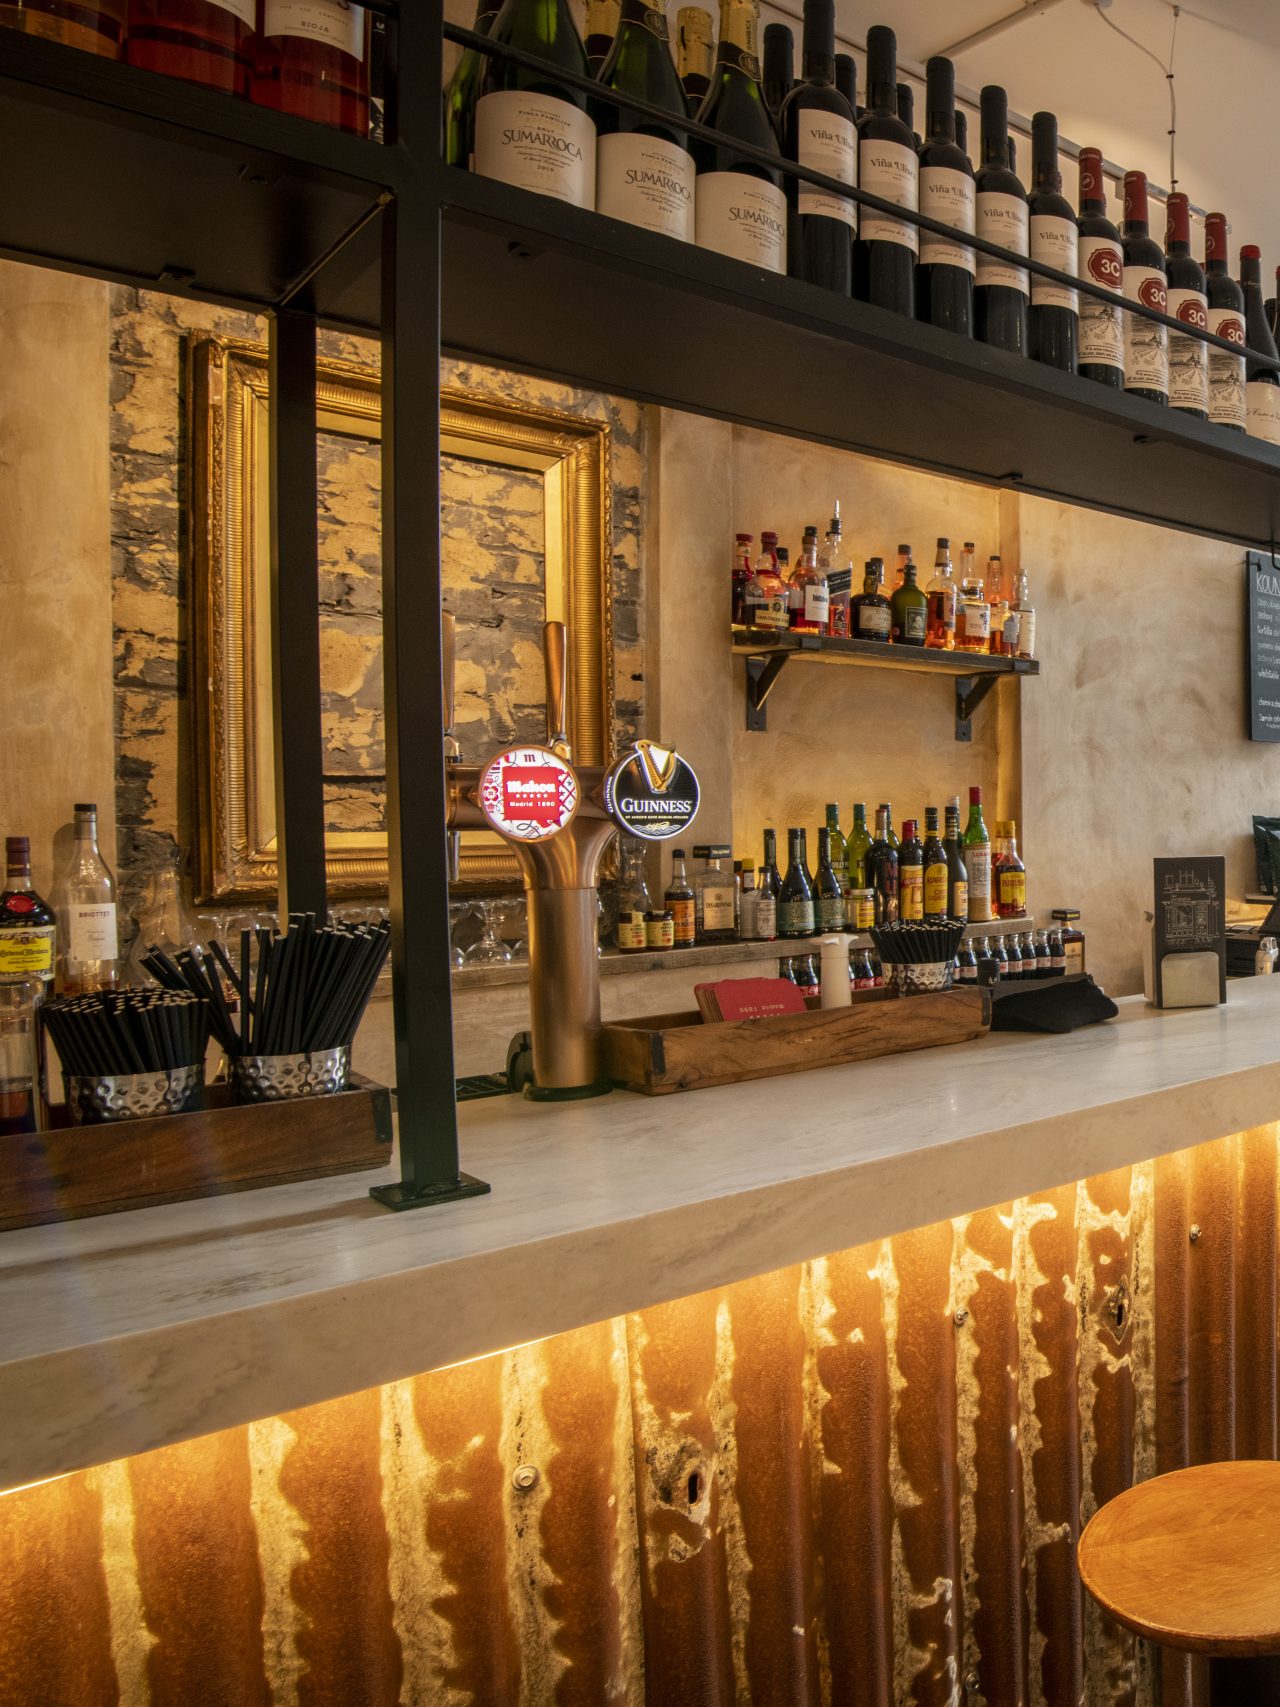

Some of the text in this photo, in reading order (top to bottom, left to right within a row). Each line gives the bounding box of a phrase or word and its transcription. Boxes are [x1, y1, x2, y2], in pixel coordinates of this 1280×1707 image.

[300, 20, 330, 33] RIOJA
[810, 129, 833, 141] Viña
[502, 129, 583, 161] SUMARROCA
[870, 158, 892, 168] Viña
[625, 169, 692, 203] SUMARROCA
[929, 184, 950, 194] Viña
[983, 208, 1004, 218] Viña
[1039, 232, 1059, 241] Viña
[1101, 259, 1120, 277] 3C
[1150, 288, 1166, 306] 3C
[1188, 309, 1206, 326] 3C
[1227, 328, 1243, 345] 3C
[621, 798, 691, 813] GUINNESS
